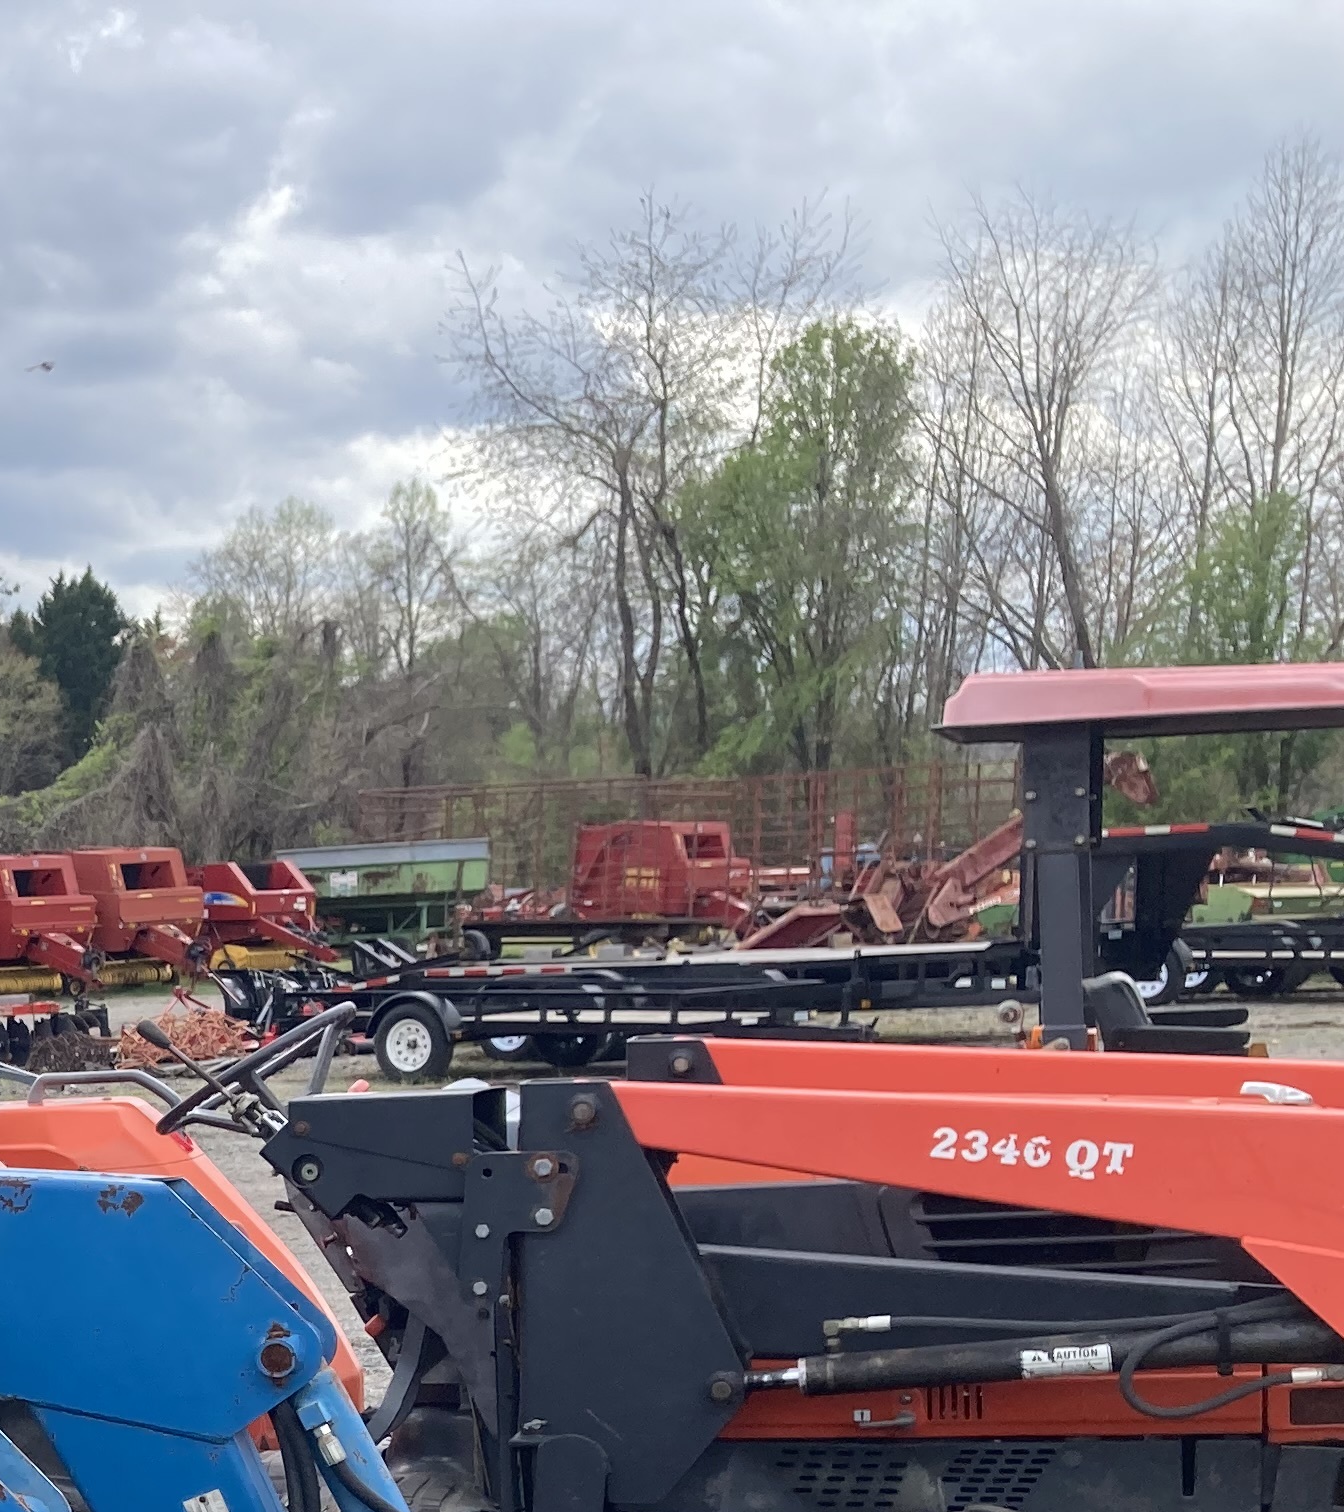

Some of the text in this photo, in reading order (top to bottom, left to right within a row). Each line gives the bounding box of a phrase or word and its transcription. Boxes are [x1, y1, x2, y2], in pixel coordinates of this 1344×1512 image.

[929, 1126, 1135, 1180] 2346 QT
[1052, 1348, 1098, 1361] AUTION
